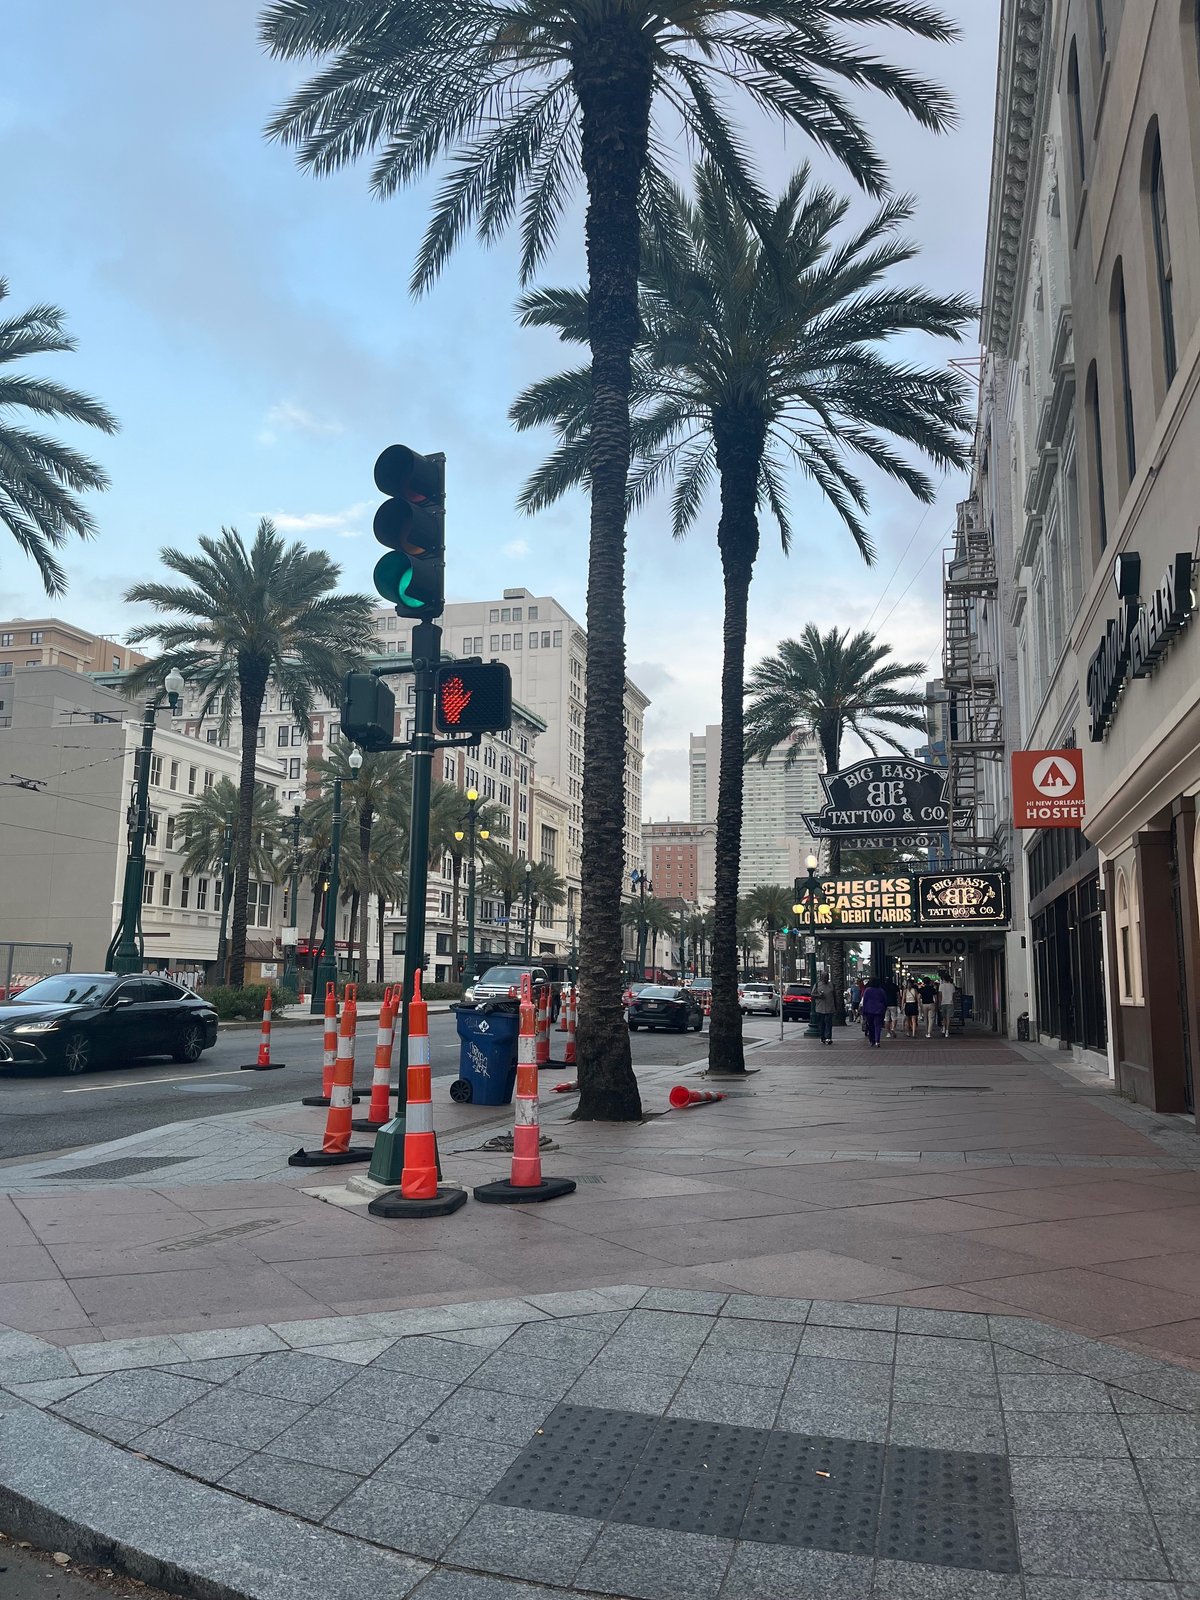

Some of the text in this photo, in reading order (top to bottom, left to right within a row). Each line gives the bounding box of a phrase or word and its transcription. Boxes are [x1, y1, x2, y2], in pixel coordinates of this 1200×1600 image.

[843, 764, 929, 788] BIG EASY
[828, 806, 948, 825] TATTOO & CO.
[1026, 808, 1086, 819] HOSTEL
[824, 878, 911, 895] CHECKS
[932, 877, 989, 891] BIG EASY
[826, 893, 911, 909] CASHED
[841, 910, 871, 924] DEBIT
[874, 908, 912, 923] CARDS
[928, 906, 996, 915] TATTOO & CO.
[903, 938, 966, 954] TATTOO
